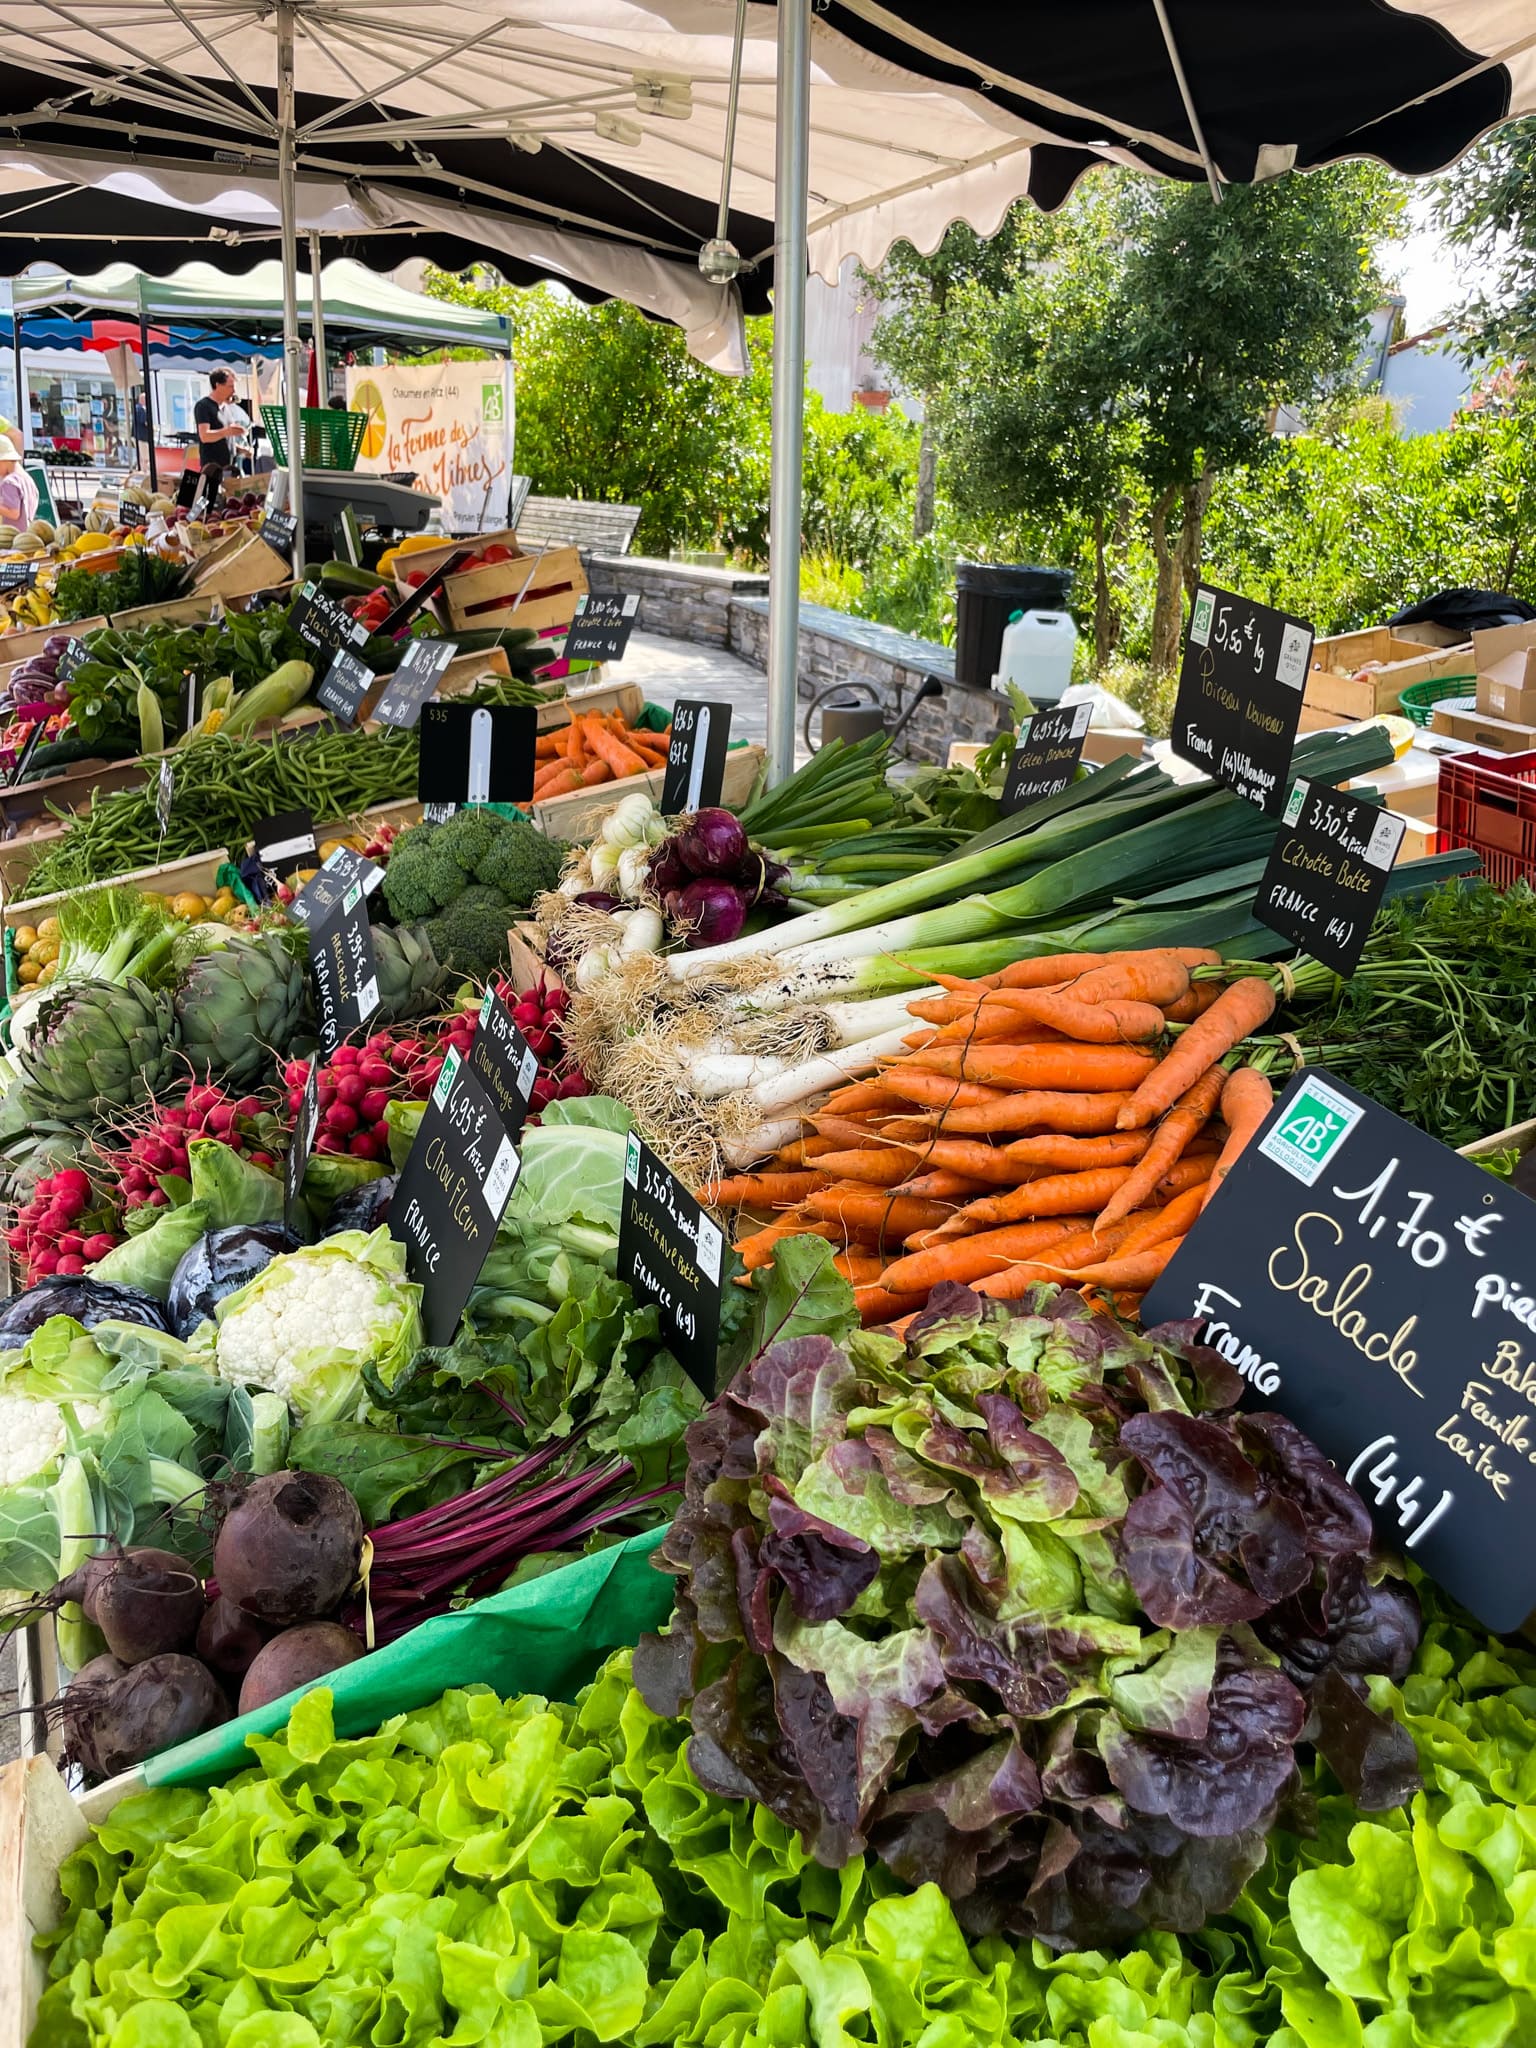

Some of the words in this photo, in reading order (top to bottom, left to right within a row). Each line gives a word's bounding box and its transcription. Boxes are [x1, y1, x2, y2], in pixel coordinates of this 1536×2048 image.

[445, 385, 460, 399] (44)
[1214, 606, 1242, 655] 5,50
[1199, 647, 1241, 712] Poireau
[430, 708, 449, 724] 535
[1309, 798, 1341, 837] 3,50
[1346, 807, 1359, 823] €
[1281, 838, 1334, 877] Carotte
[1335, 859, 1373, 893] Botte
[1324, 916, 1355, 949] (44)
[474, 1040, 494, 1079] Chou
[492, 1068, 513, 1113] Rouge
[449, 1080, 476, 1136] 4,95
[474, 1113, 488, 1134] €
[1280, 1114, 1329, 1155] AB
[425, 1137, 456, 1193] Chou
[1266, 1141, 1313, 1177] BIOLOGIQUE
[1271, 1134, 1318, 1171] AGRICULTURE
[644, 1164, 667, 1204] 3,50
[1332, 1157, 1448, 1268] 1,70
[1453, 1213, 1505, 1258] €
[1268, 1211, 1426, 1399] Salade
[1461, 1381, 1530, 1454] Feuille
[1435, 1413, 1512, 1502] Laitue
[1345, 1434, 1455, 1548] (44)
